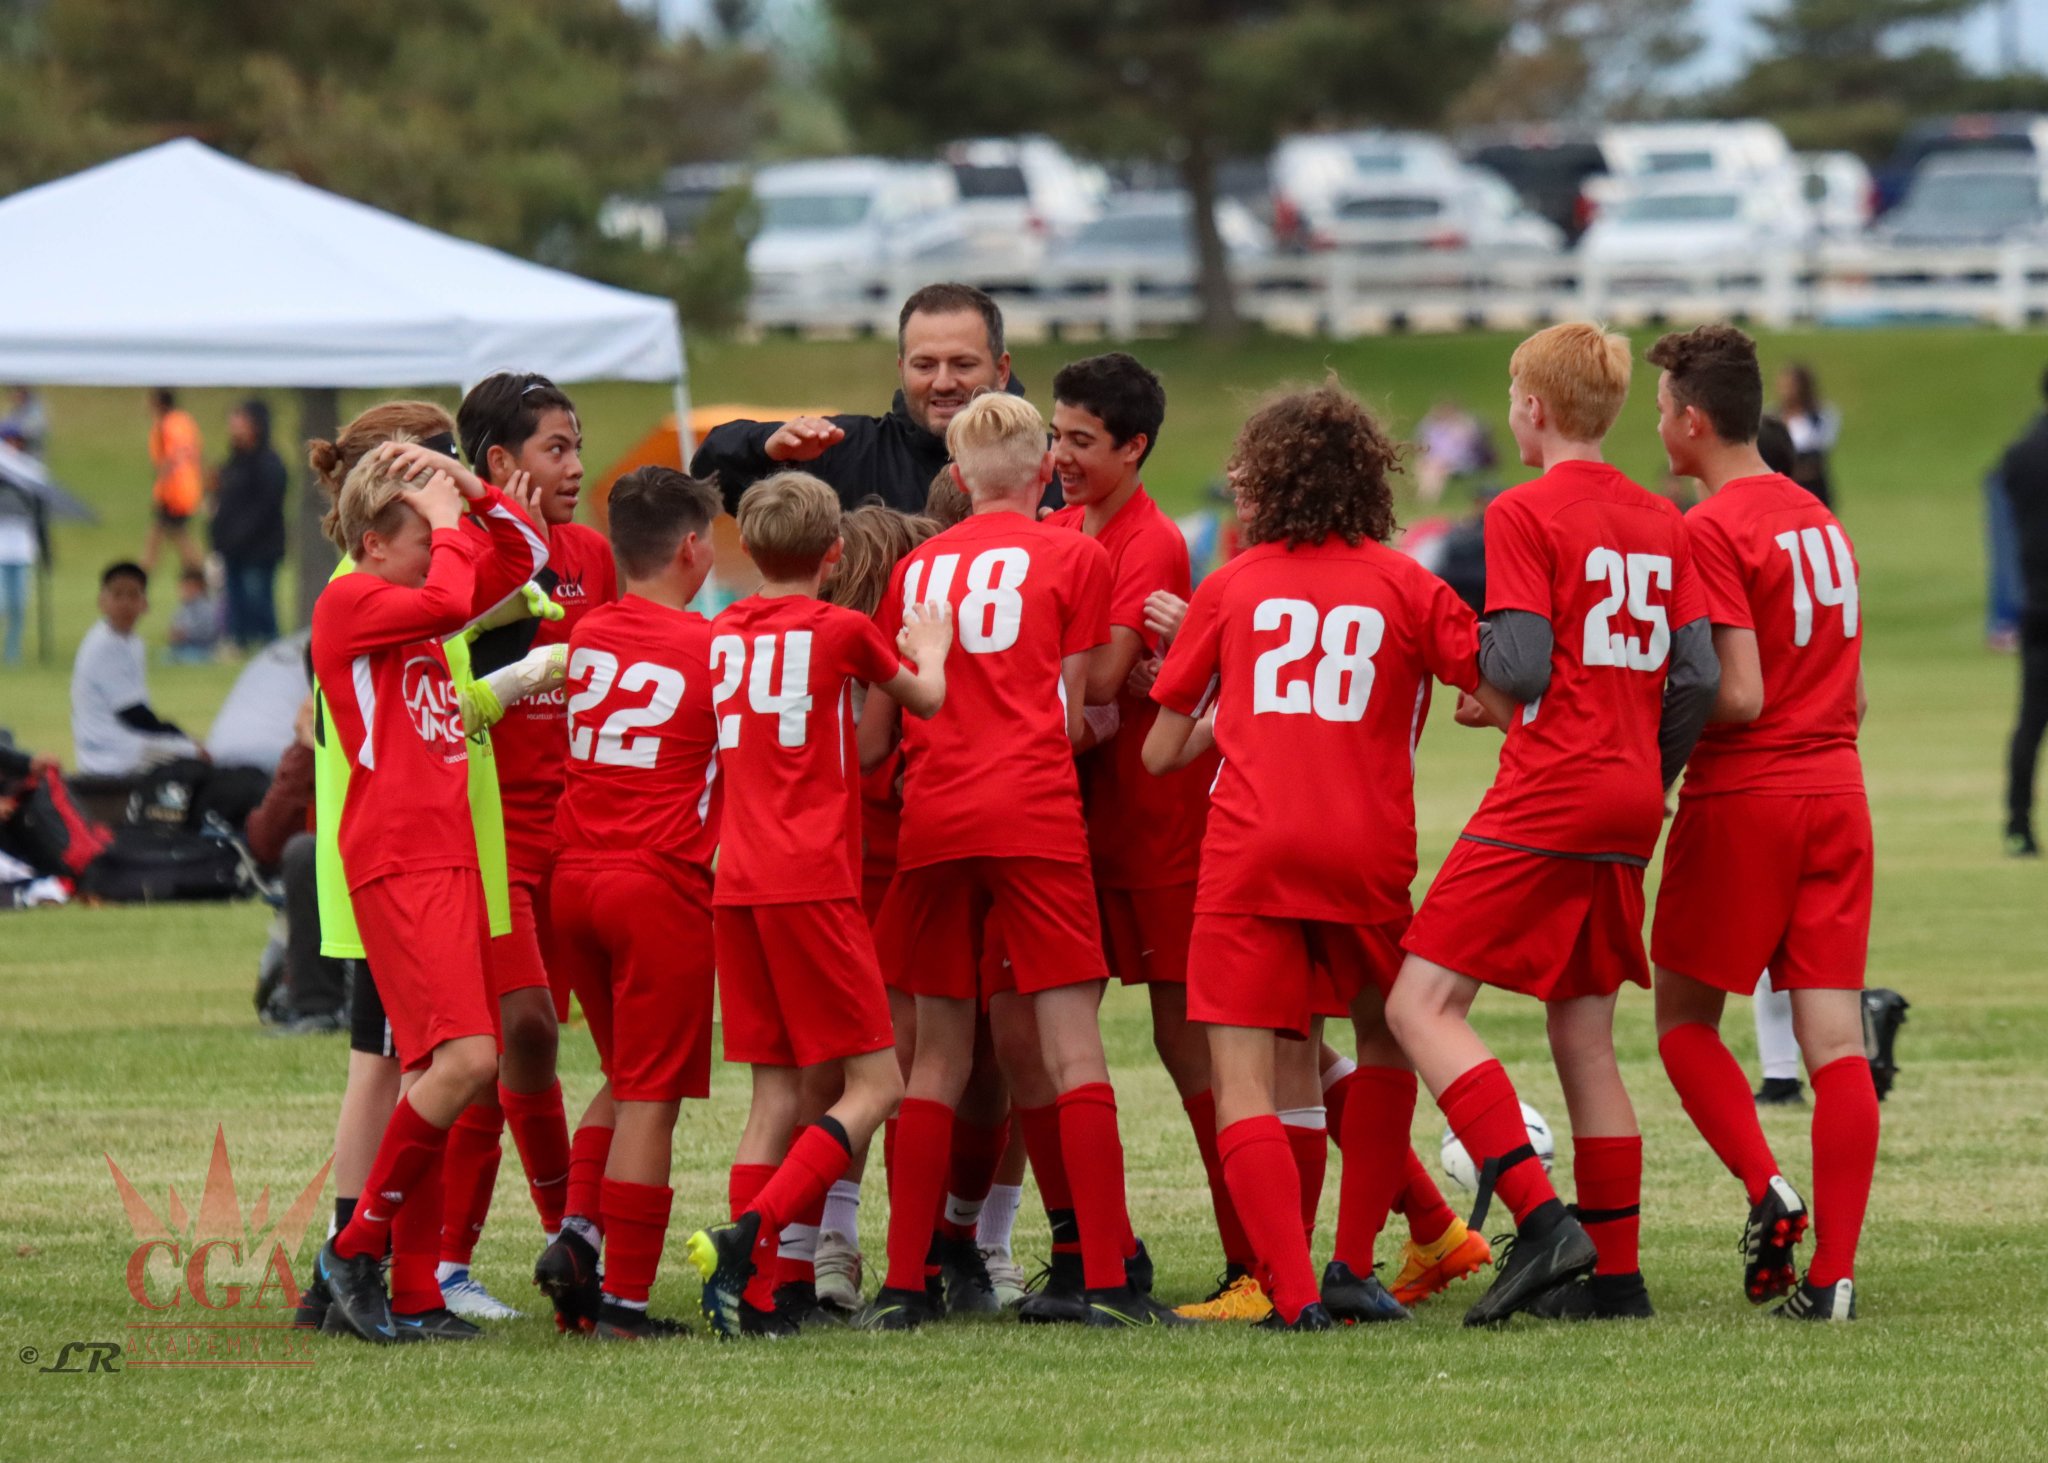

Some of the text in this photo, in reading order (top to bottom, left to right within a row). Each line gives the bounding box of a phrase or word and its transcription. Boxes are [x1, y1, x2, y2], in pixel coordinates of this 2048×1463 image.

[556, 583, 585, 598] CGA
[903, 547, 1030, 654] 48
[1582, 546, 1672, 672] 25
[1774, 525, 1858, 647] 14
[568, 647, 685, 769] 22
[709, 630, 813, 748] 24
[1252, 597, 1385, 722] 28
